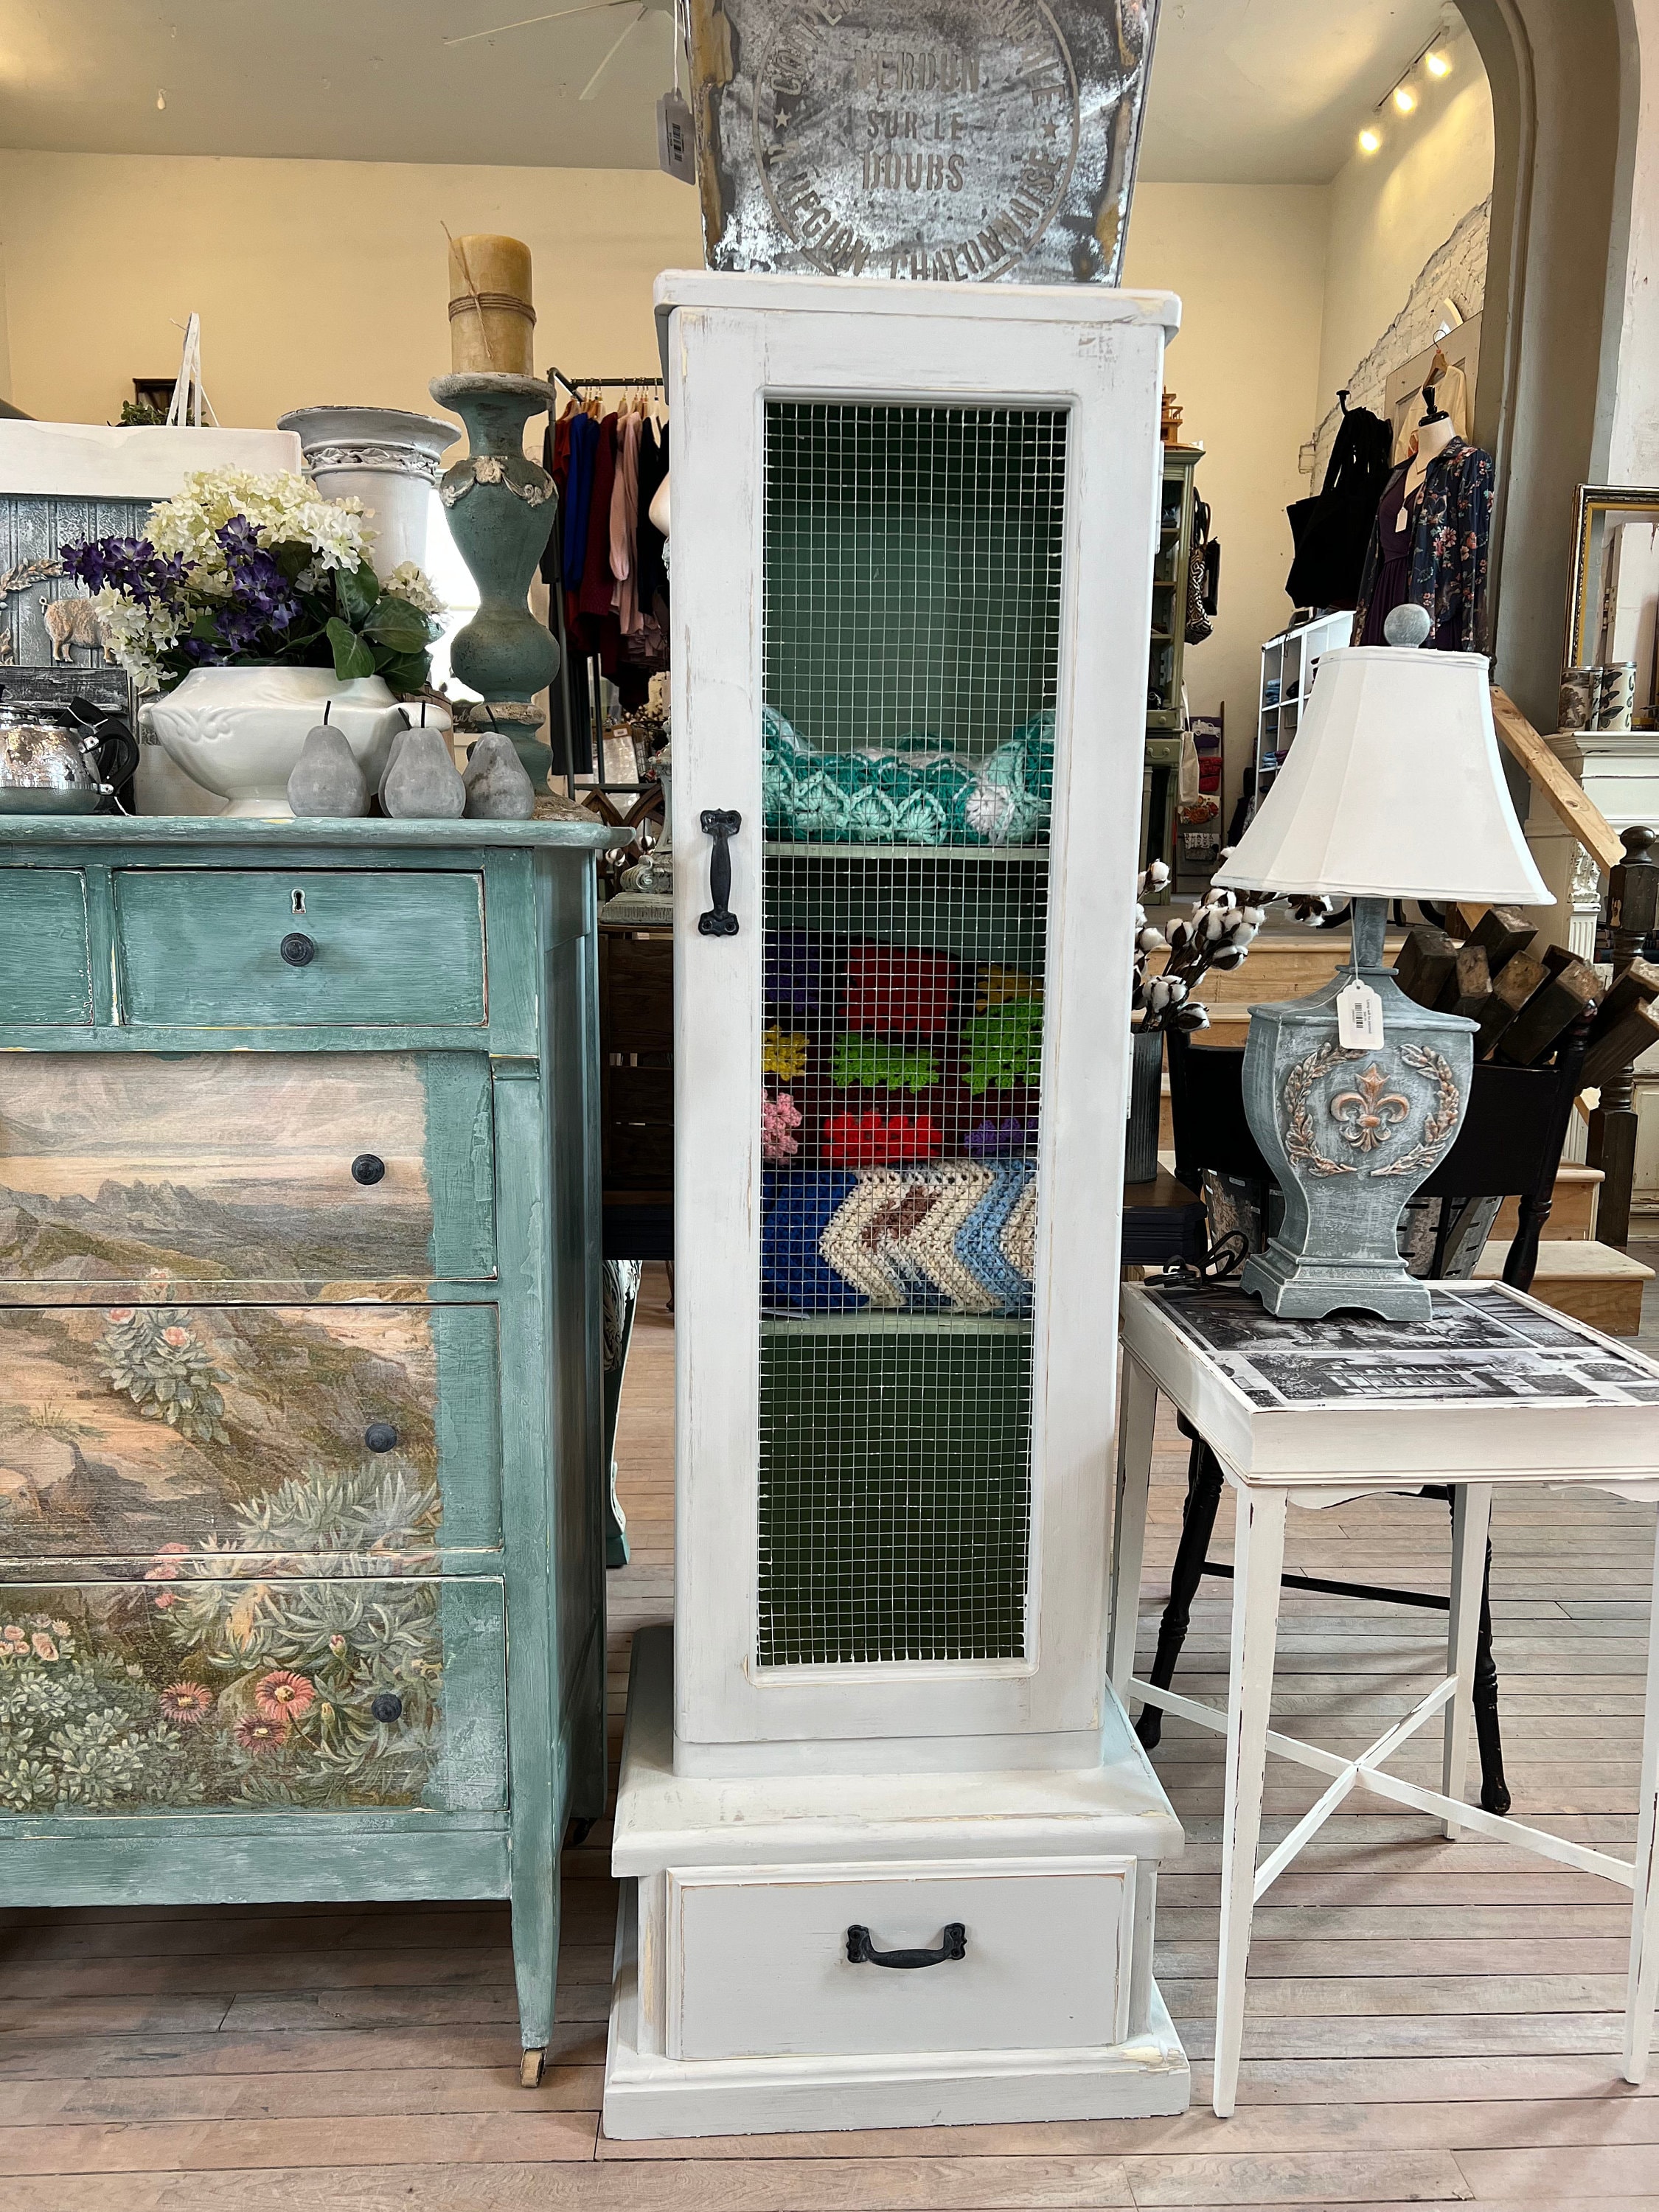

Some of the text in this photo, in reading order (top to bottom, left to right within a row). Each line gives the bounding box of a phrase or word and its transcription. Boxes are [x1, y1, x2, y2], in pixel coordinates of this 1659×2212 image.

[855, 49, 980, 93] VERDUN
[867, 108, 964, 141] SUR LE
[863, 153, 964, 192] DOUBS
